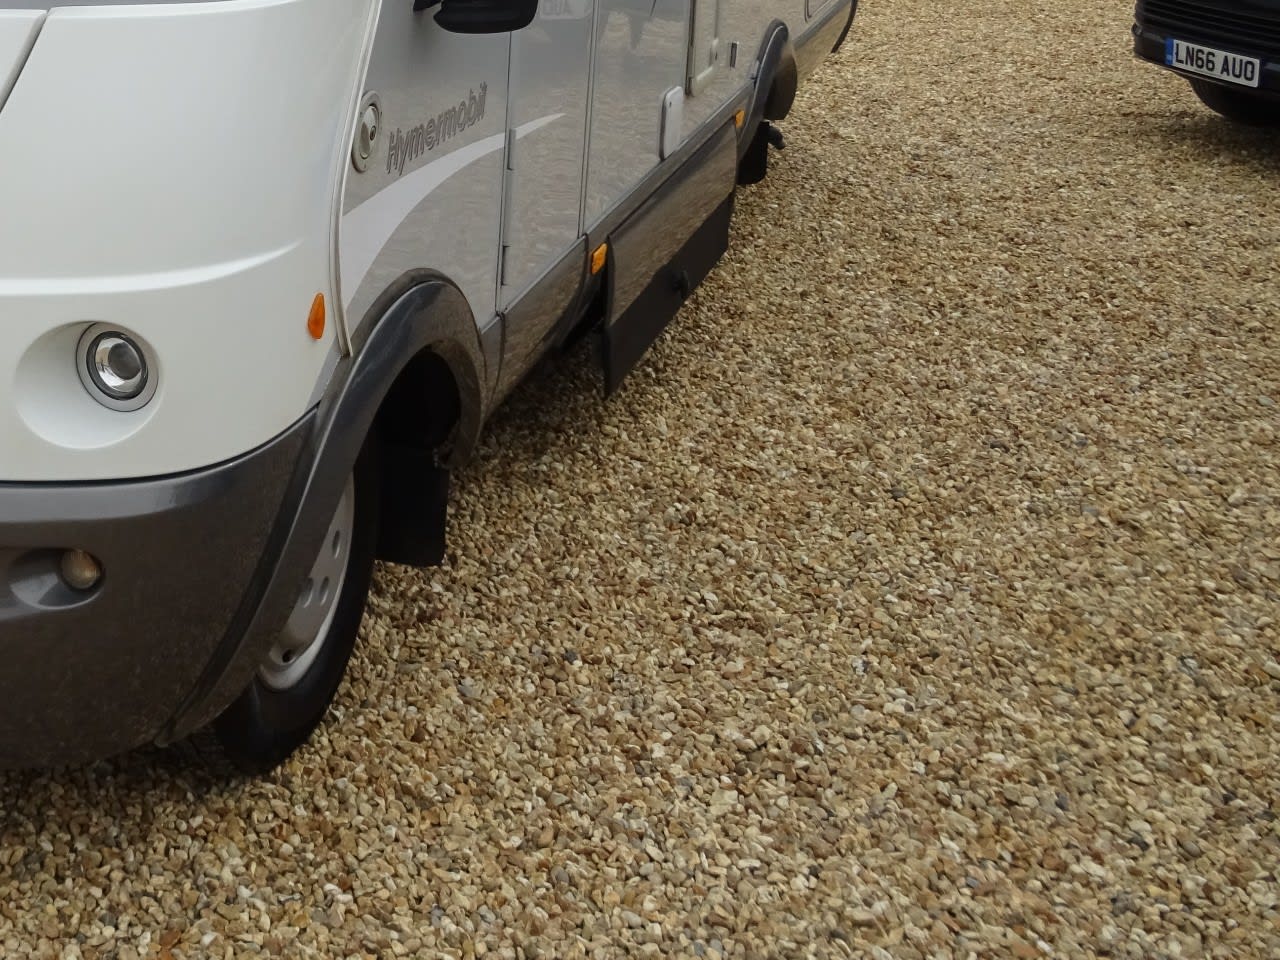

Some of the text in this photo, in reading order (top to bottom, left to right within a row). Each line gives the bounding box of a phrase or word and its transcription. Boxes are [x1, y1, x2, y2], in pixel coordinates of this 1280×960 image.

[1175, 43, 1255, 82] LN66 AUO
[385, 80, 488, 176] Hymermobil
